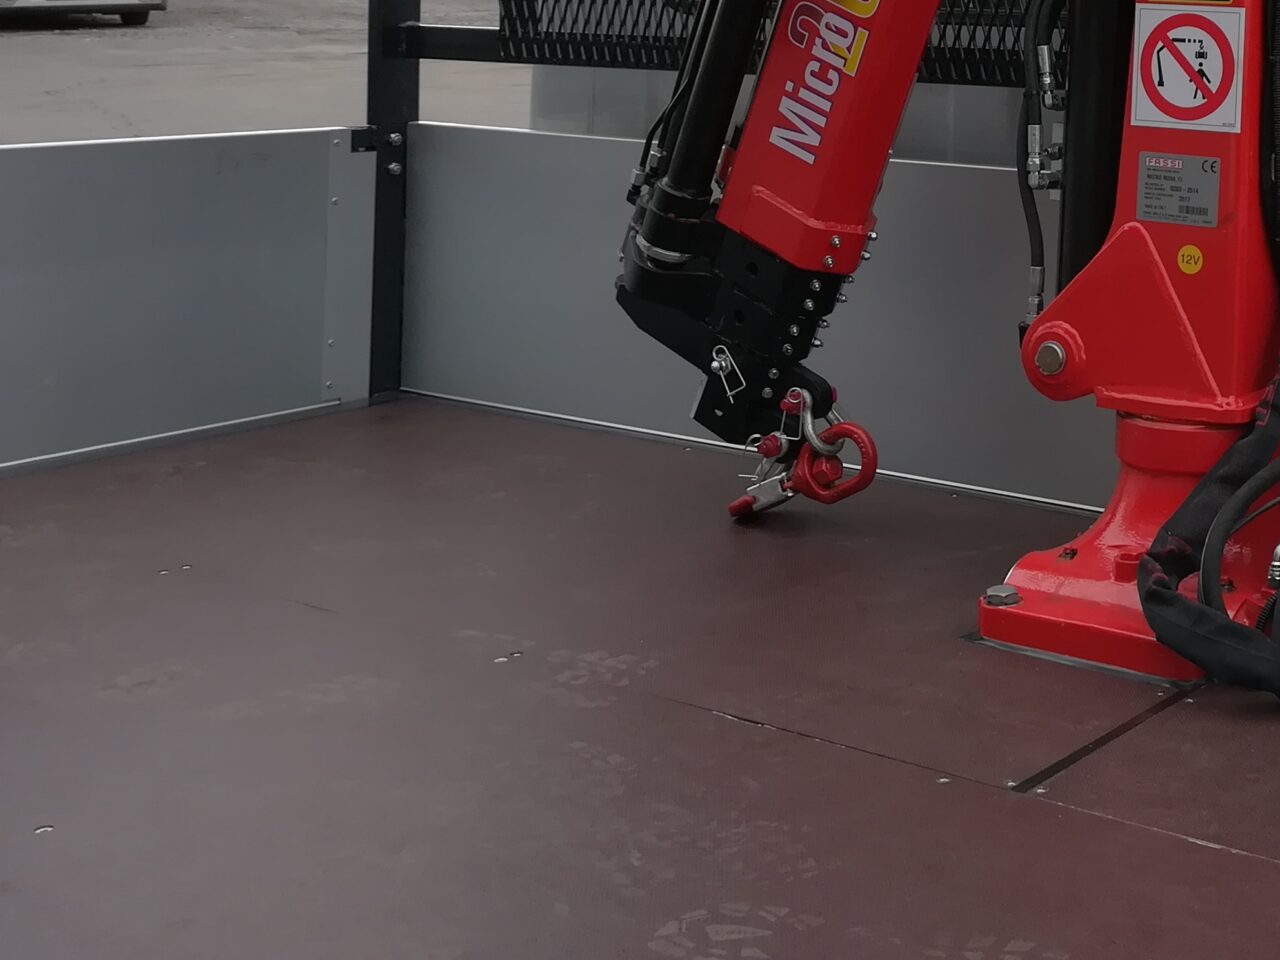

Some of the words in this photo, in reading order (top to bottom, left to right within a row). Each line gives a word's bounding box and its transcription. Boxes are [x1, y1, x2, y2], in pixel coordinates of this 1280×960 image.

[768, 12, 855, 165] Micro
[1147, 157, 1183, 169] FASSI
[1201, 159, 1217, 174] CE
[1179, 254, 1200, 265] 12V
